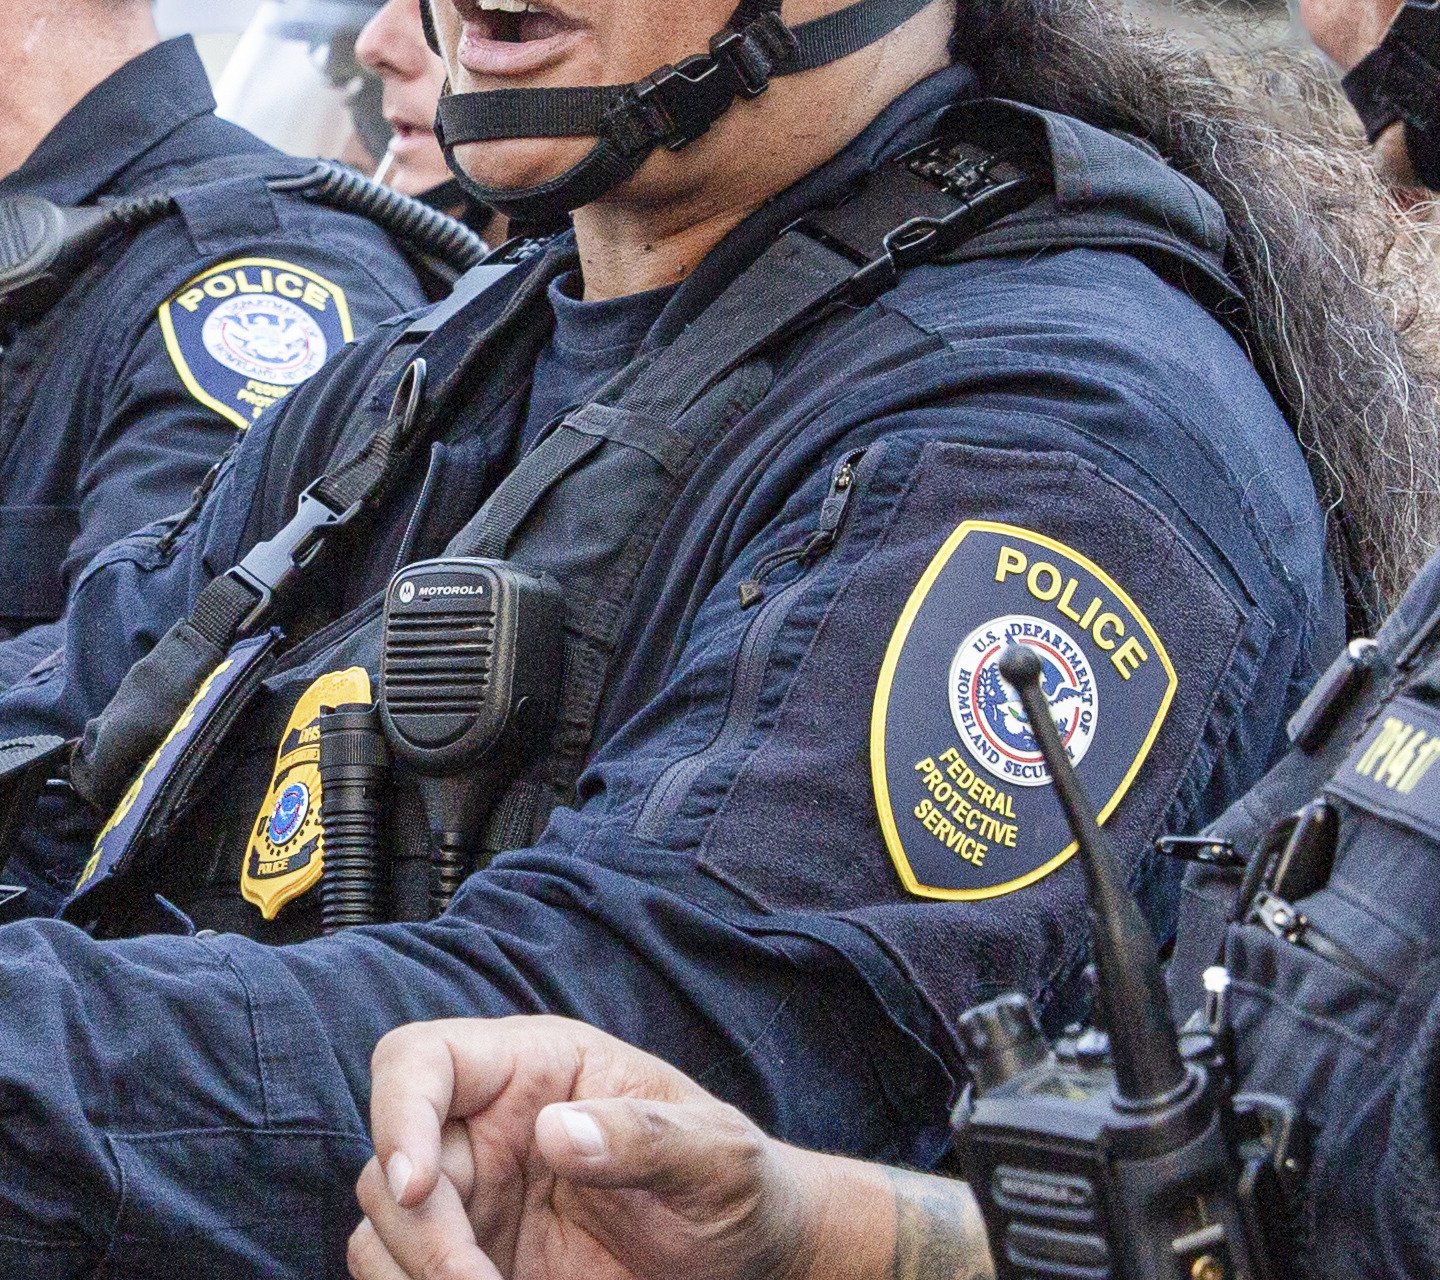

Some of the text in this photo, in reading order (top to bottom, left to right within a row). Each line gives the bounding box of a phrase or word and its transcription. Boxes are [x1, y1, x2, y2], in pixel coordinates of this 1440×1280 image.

[176, 269, 332, 314] POLICE
[418, 585, 484, 596] MOTOROLA
[995, 545, 1148, 680] POLICE
[973, 622, 1095, 736] U.S. DEPARTMENT OF
[953, 668, 1001, 766] HOMELAND
[915, 756, 1018, 849] PROTECTIVE
[937, 746, 1017, 820] FEDERAL
[257, 857, 289, 877] POLICE
[913, 798, 988, 869] SERVICE
